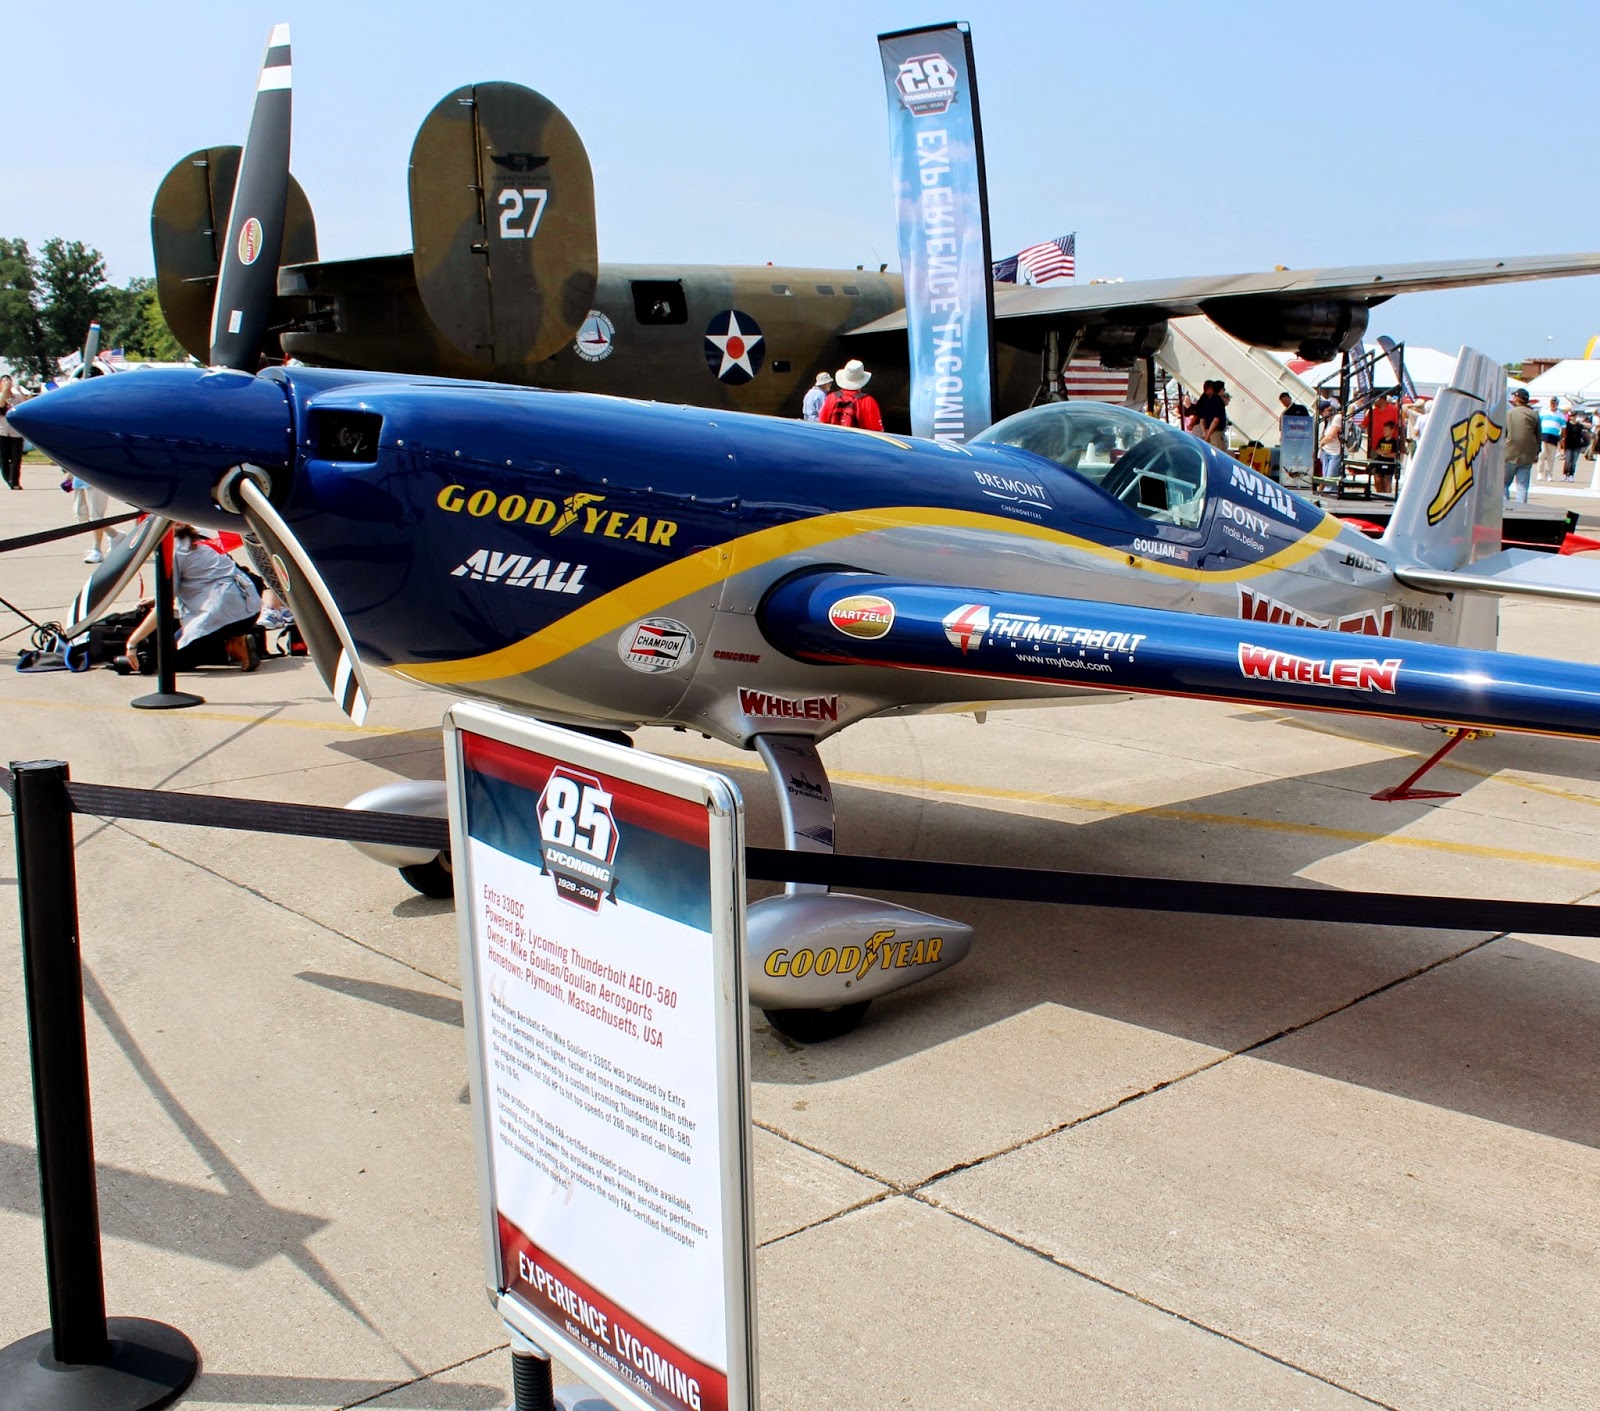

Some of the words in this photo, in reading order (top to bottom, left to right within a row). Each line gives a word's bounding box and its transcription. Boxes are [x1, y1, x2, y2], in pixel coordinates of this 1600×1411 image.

[498, 189, 547, 239] 27
[974, 470, 1045, 500] BREMONT
[1229, 464, 1297, 521] AVIALL
[1001, 504, 1042, 520] CHRONOMETERS
[1221, 499, 1269, 538] SONY
[1133, 537, 1176, 558] GOULIAN
[1222, 524, 1265, 554] make.believe
[450, 549, 588, 595] AVIALL
[1342, 551, 1384, 574] BOSE
[832, 608, 889, 624] HARTZELL
[1401, 605, 1434, 633] N821MG
[637, 635, 680, 651] CHAMPION
[991, 618, 1147, 654] THUNDERBOLT
[626, 654, 679, 669] AEROSPACE
[713, 650, 761, 664] CONCORDE
[1239, 643, 1401, 694] WHELEN
[738, 687, 838, 722] WHELEN
[788, 785, 829, 803] Dynamics
[542, 776, 613, 862] 85
[546, 847, 610, 882] LYCOMING
[483, 884, 501, 906] Extra
[501, 895, 525, 919] 330SC
[485, 905, 514, 933] Powered
[514, 922, 527, 942] By:
[528, 929, 569, 964] Lycoming
[570, 949, 627, 987] Thunderbolt
[628, 975, 678, 1008] AEIO-580
[486, 925, 509, 950] Owner:
[510, 940, 528, 962] Mike
[529, 951, 597, 995] Goulian/Goulian
[598, 984, 653, 1021] Aerosports
[487, 945, 524, 979] Hometown:
[525, 968, 565, 1003] Plymouth,
[567, 991, 640, 1039] Massachusetts,
[642, 1025, 663, 1048] USA
[593, 1054, 613, 1072] 330SC
[614, 1067, 626, 1079] was
[627, 1073, 658, 1095] produced
[668, 1090, 687, 1108] Extra
[586, 1069, 598, 1082] and
[598, 1076, 614, 1090] more
[615, 1085, 660, 1113] maneuverable
[661, 1106, 677, 1122] than
[678, 1116, 698, 1131] other
[591, 1087, 620, 1113] Lycoming
[621, 1102, 659, 1130] Thunderbolt
[574, 1094, 584, 1108] top
[584, 1102, 605, 1119] speeds
[613, 1115, 626, 1130] 260
[626, 1125, 640, 1138] mph
[641, 1132, 654, 1145] and
[654, 1140, 667, 1152] can
[668, 1144, 692, 1165] handle
[518, 1251, 611, 1345] EXPERIENCE
[613, 1323, 701, 1411] LYCOMING
[565, 1319, 581, 1341] Visit
[580, 1333, 590, 1347] us
[590, 1339, 598, 1354] at
[598, 1346, 619, 1371] Booth
